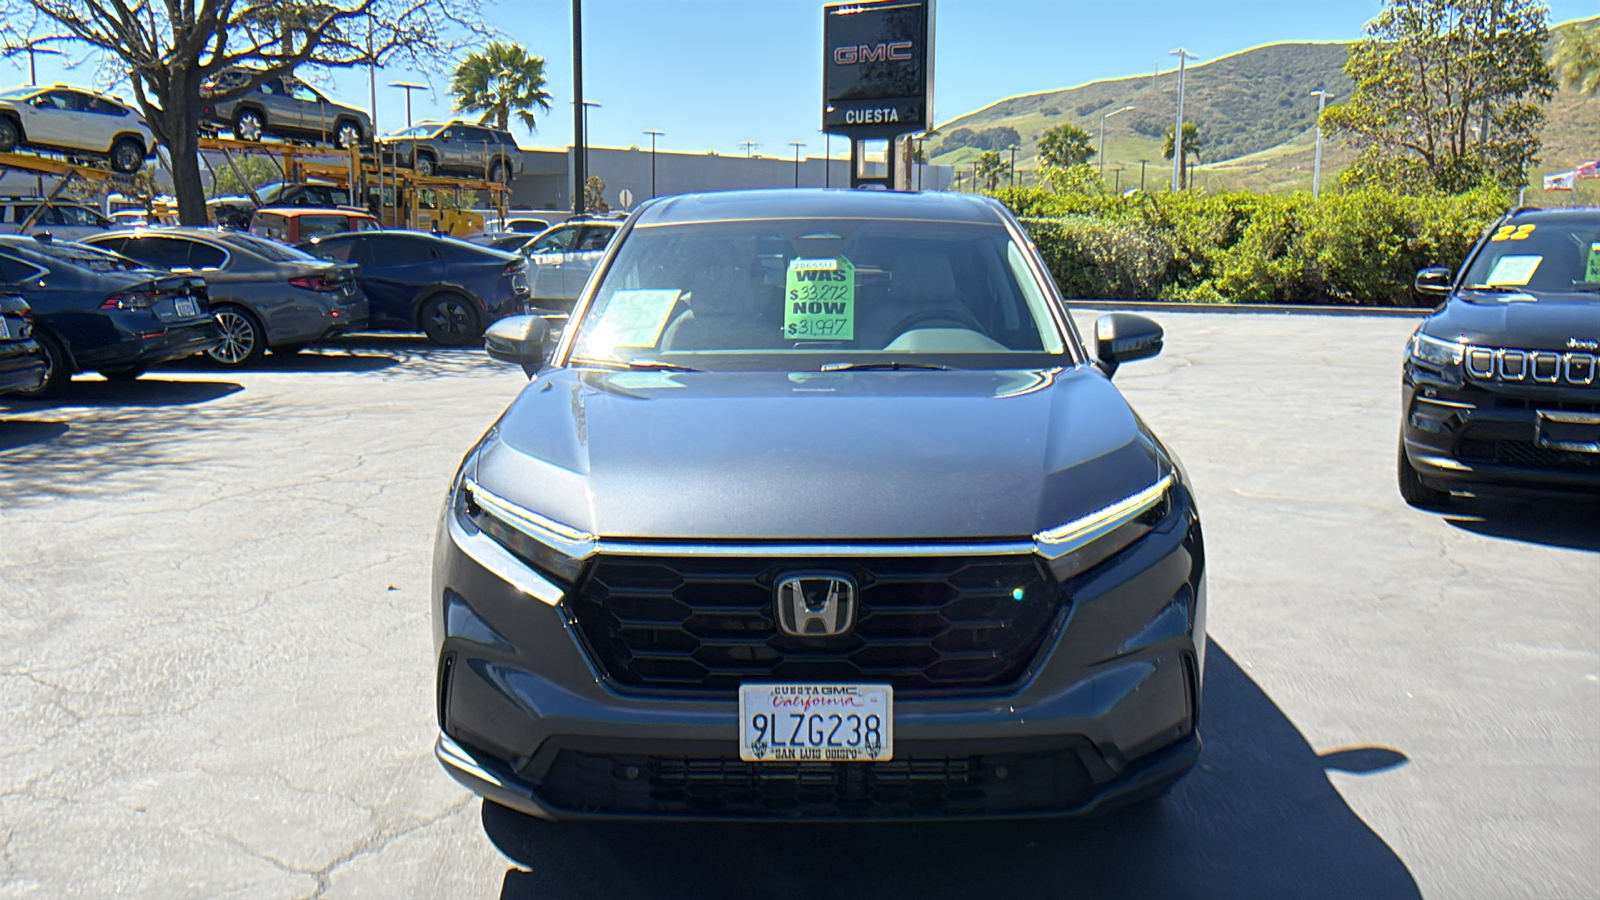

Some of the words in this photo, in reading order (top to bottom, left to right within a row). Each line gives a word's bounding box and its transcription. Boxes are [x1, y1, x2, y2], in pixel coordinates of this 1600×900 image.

[834, 41, 912, 65] GMC
[845, 107, 899, 124] CUESTA
[1491, 224, 1537, 242] 22
[795, 269, 847, 282] WAS
[793, 301, 847, 314] NOW
[774, 686, 819, 695] CUESTA
[821, 686, 858, 695] GMC
[772, 694, 864, 711] California
[752, 712, 881, 747] 9LZG238
[775, 748, 796, 759] SAN
[800, 748, 822, 759] LUIS
